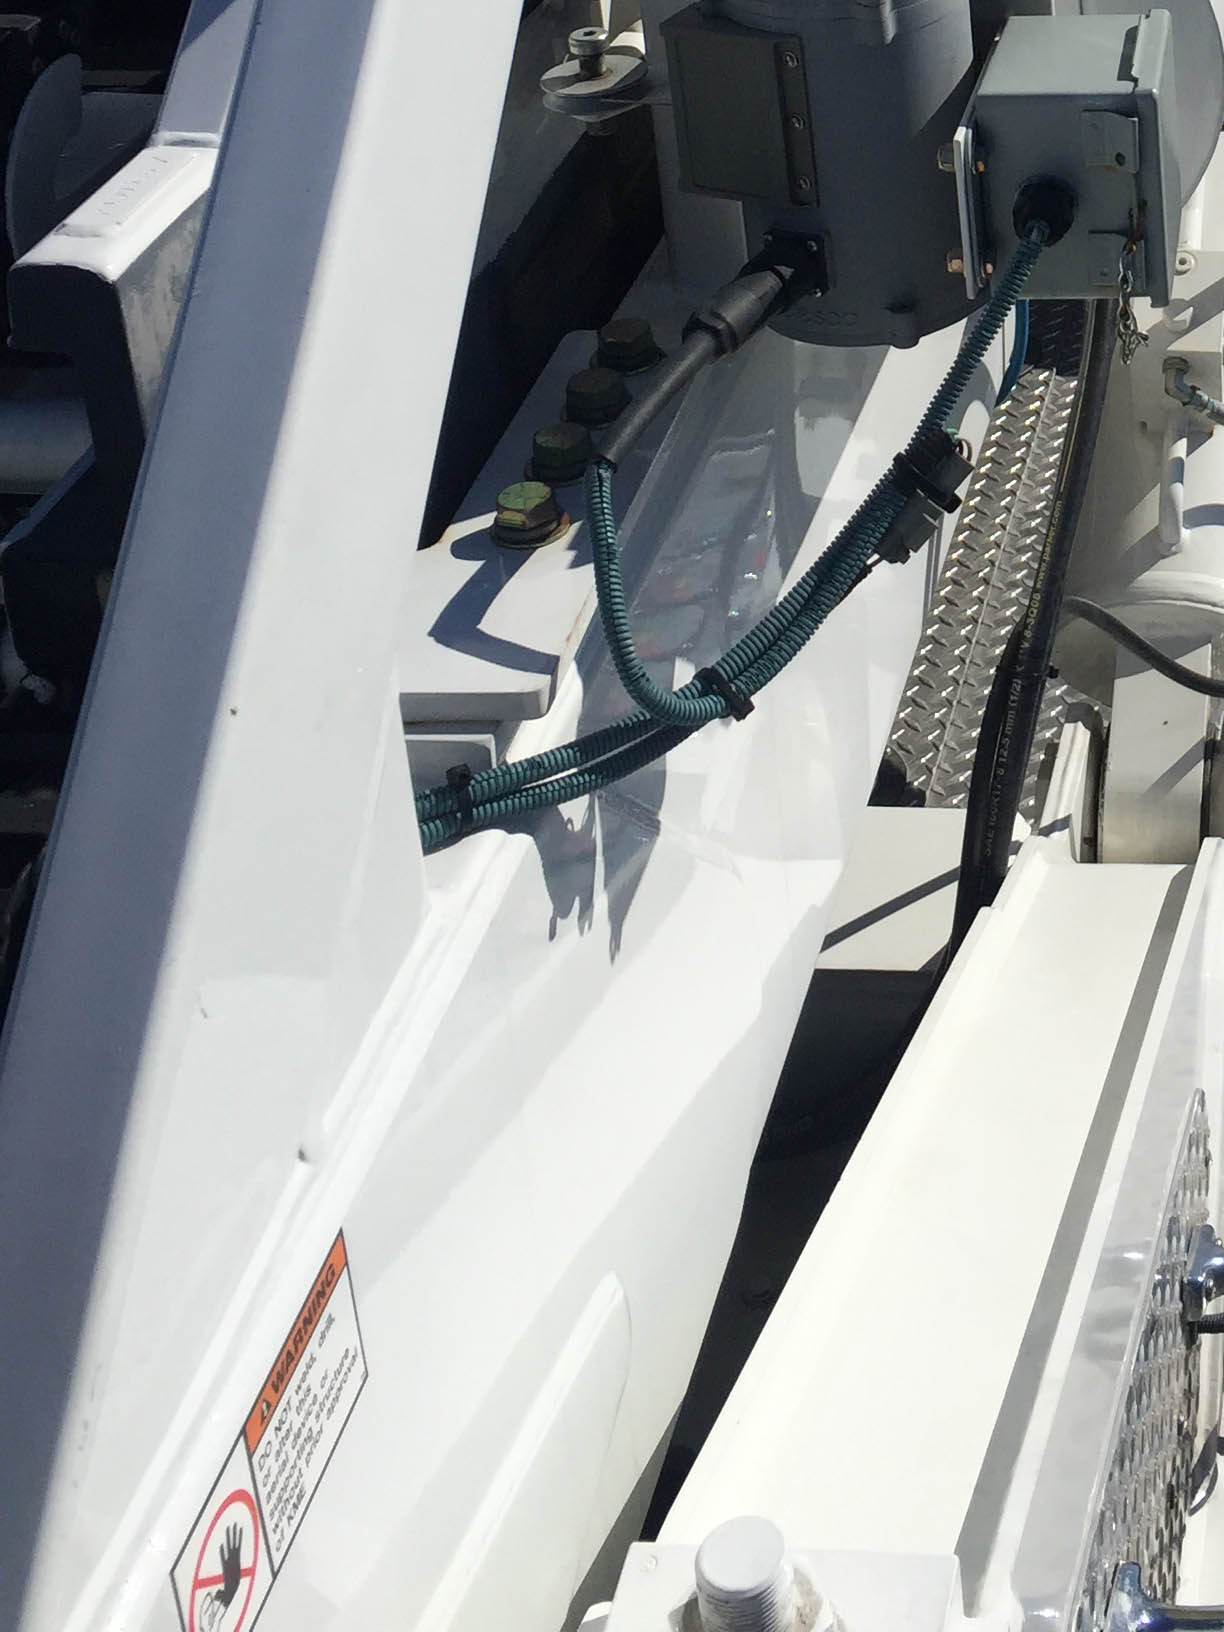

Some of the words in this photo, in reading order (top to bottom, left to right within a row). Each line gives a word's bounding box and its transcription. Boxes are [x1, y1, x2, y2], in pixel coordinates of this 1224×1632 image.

[271, 1263, 335, 1394] WARNING
[258, 1441, 272, 1472] DO
[274, 1396, 292, 1439] NOT
[269, 1427, 313, 1521] supporting
[315, 1347, 349, 1423] structure
[273, 1468, 303, 1534] without
[305, 1424, 323, 1468] prior
[326, 1346, 358, 1421] approval
[275, 1420, 293, 1462] alter
[296, 1383, 312, 1416] this
[291, 1393, 318, 1450] device
[320, 1368, 328, 1389] or
[287, 1482, 306, 1527] KME
